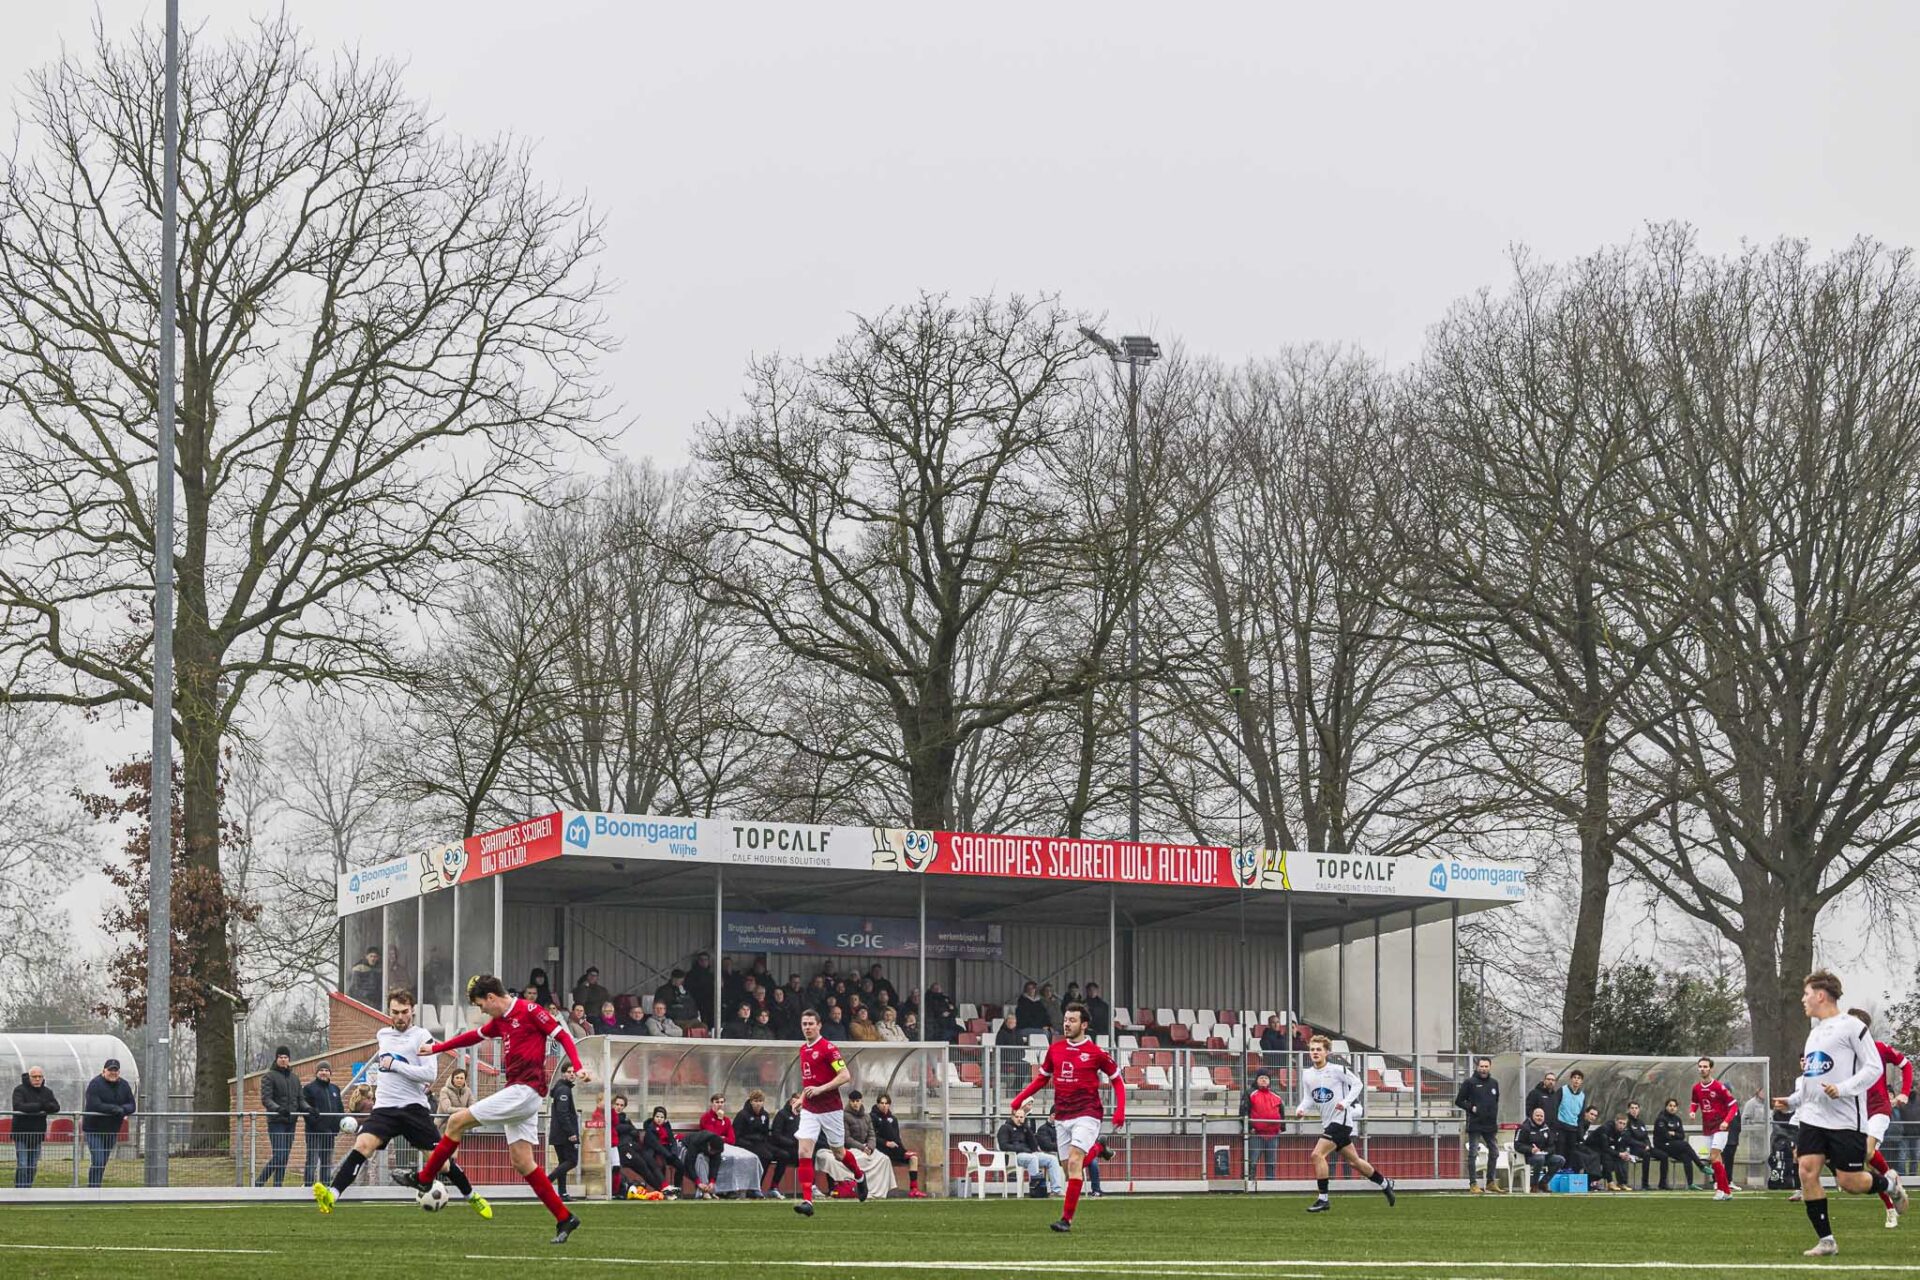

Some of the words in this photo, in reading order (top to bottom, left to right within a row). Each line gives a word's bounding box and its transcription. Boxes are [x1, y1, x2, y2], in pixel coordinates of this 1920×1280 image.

[480, 829, 521, 855] SAAMPIES
[521, 818, 552, 844] SCOREN
[595, 815, 698, 843] Boomgaard
[732, 827, 831, 852] TOPCALF
[481, 852, 496, 875] WIJ
[498, 846, 527, 870] ALTIJD!
[669, 843, 698, 857] Wijhe
[732, 853, 752, 863] CALF
[754, 855, 788, 865] HOUSING
[790, 857, 832, 866] SOLUTIONS
[951, 836, 1042, 876] SAAMPIES
[1048, 841, 1114, 879] SCOREN
[1120, 845, 1152, 881] WIJ
[1158, 848, 1218, 884] ALTIJD!
[361, 860, 408, 882] Boomgaard
[1316, 859, 1396, 881] TOPCALF
[355, 887, 390, 905] TOPCALF
[837, 933, 884, 948] SPIE
[924, 944, 945, 954] rengt
